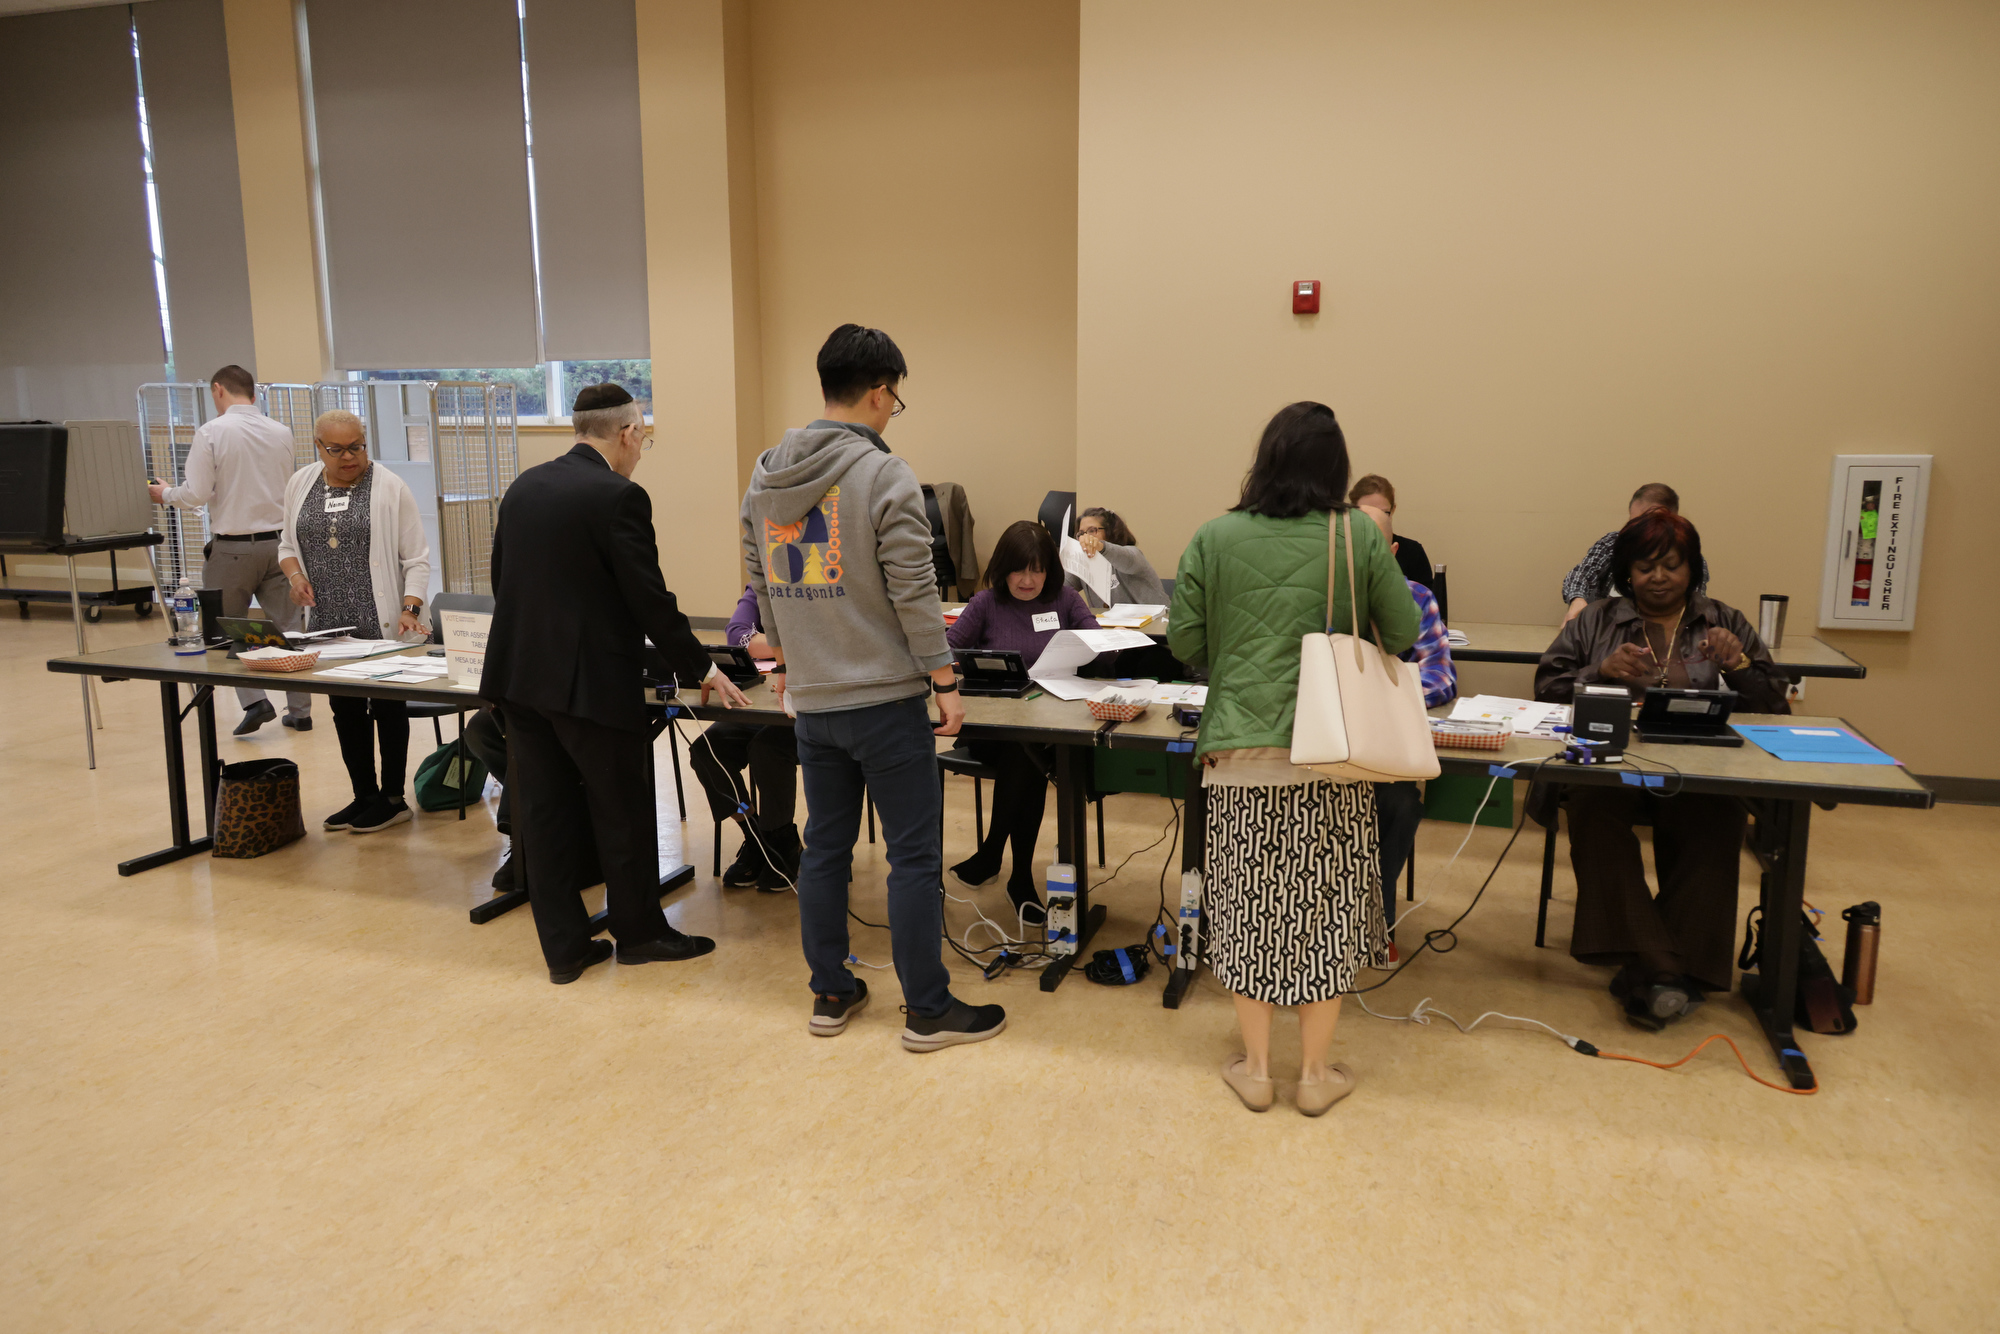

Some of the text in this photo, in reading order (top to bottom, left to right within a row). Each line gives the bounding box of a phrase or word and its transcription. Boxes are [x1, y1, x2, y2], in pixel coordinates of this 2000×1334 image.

[1881, 477, 1903, 610] FIRE EXTINGUISHER
[770, 586, 846, 600] patagonia
[452, 630, 469, 638] VOTER
